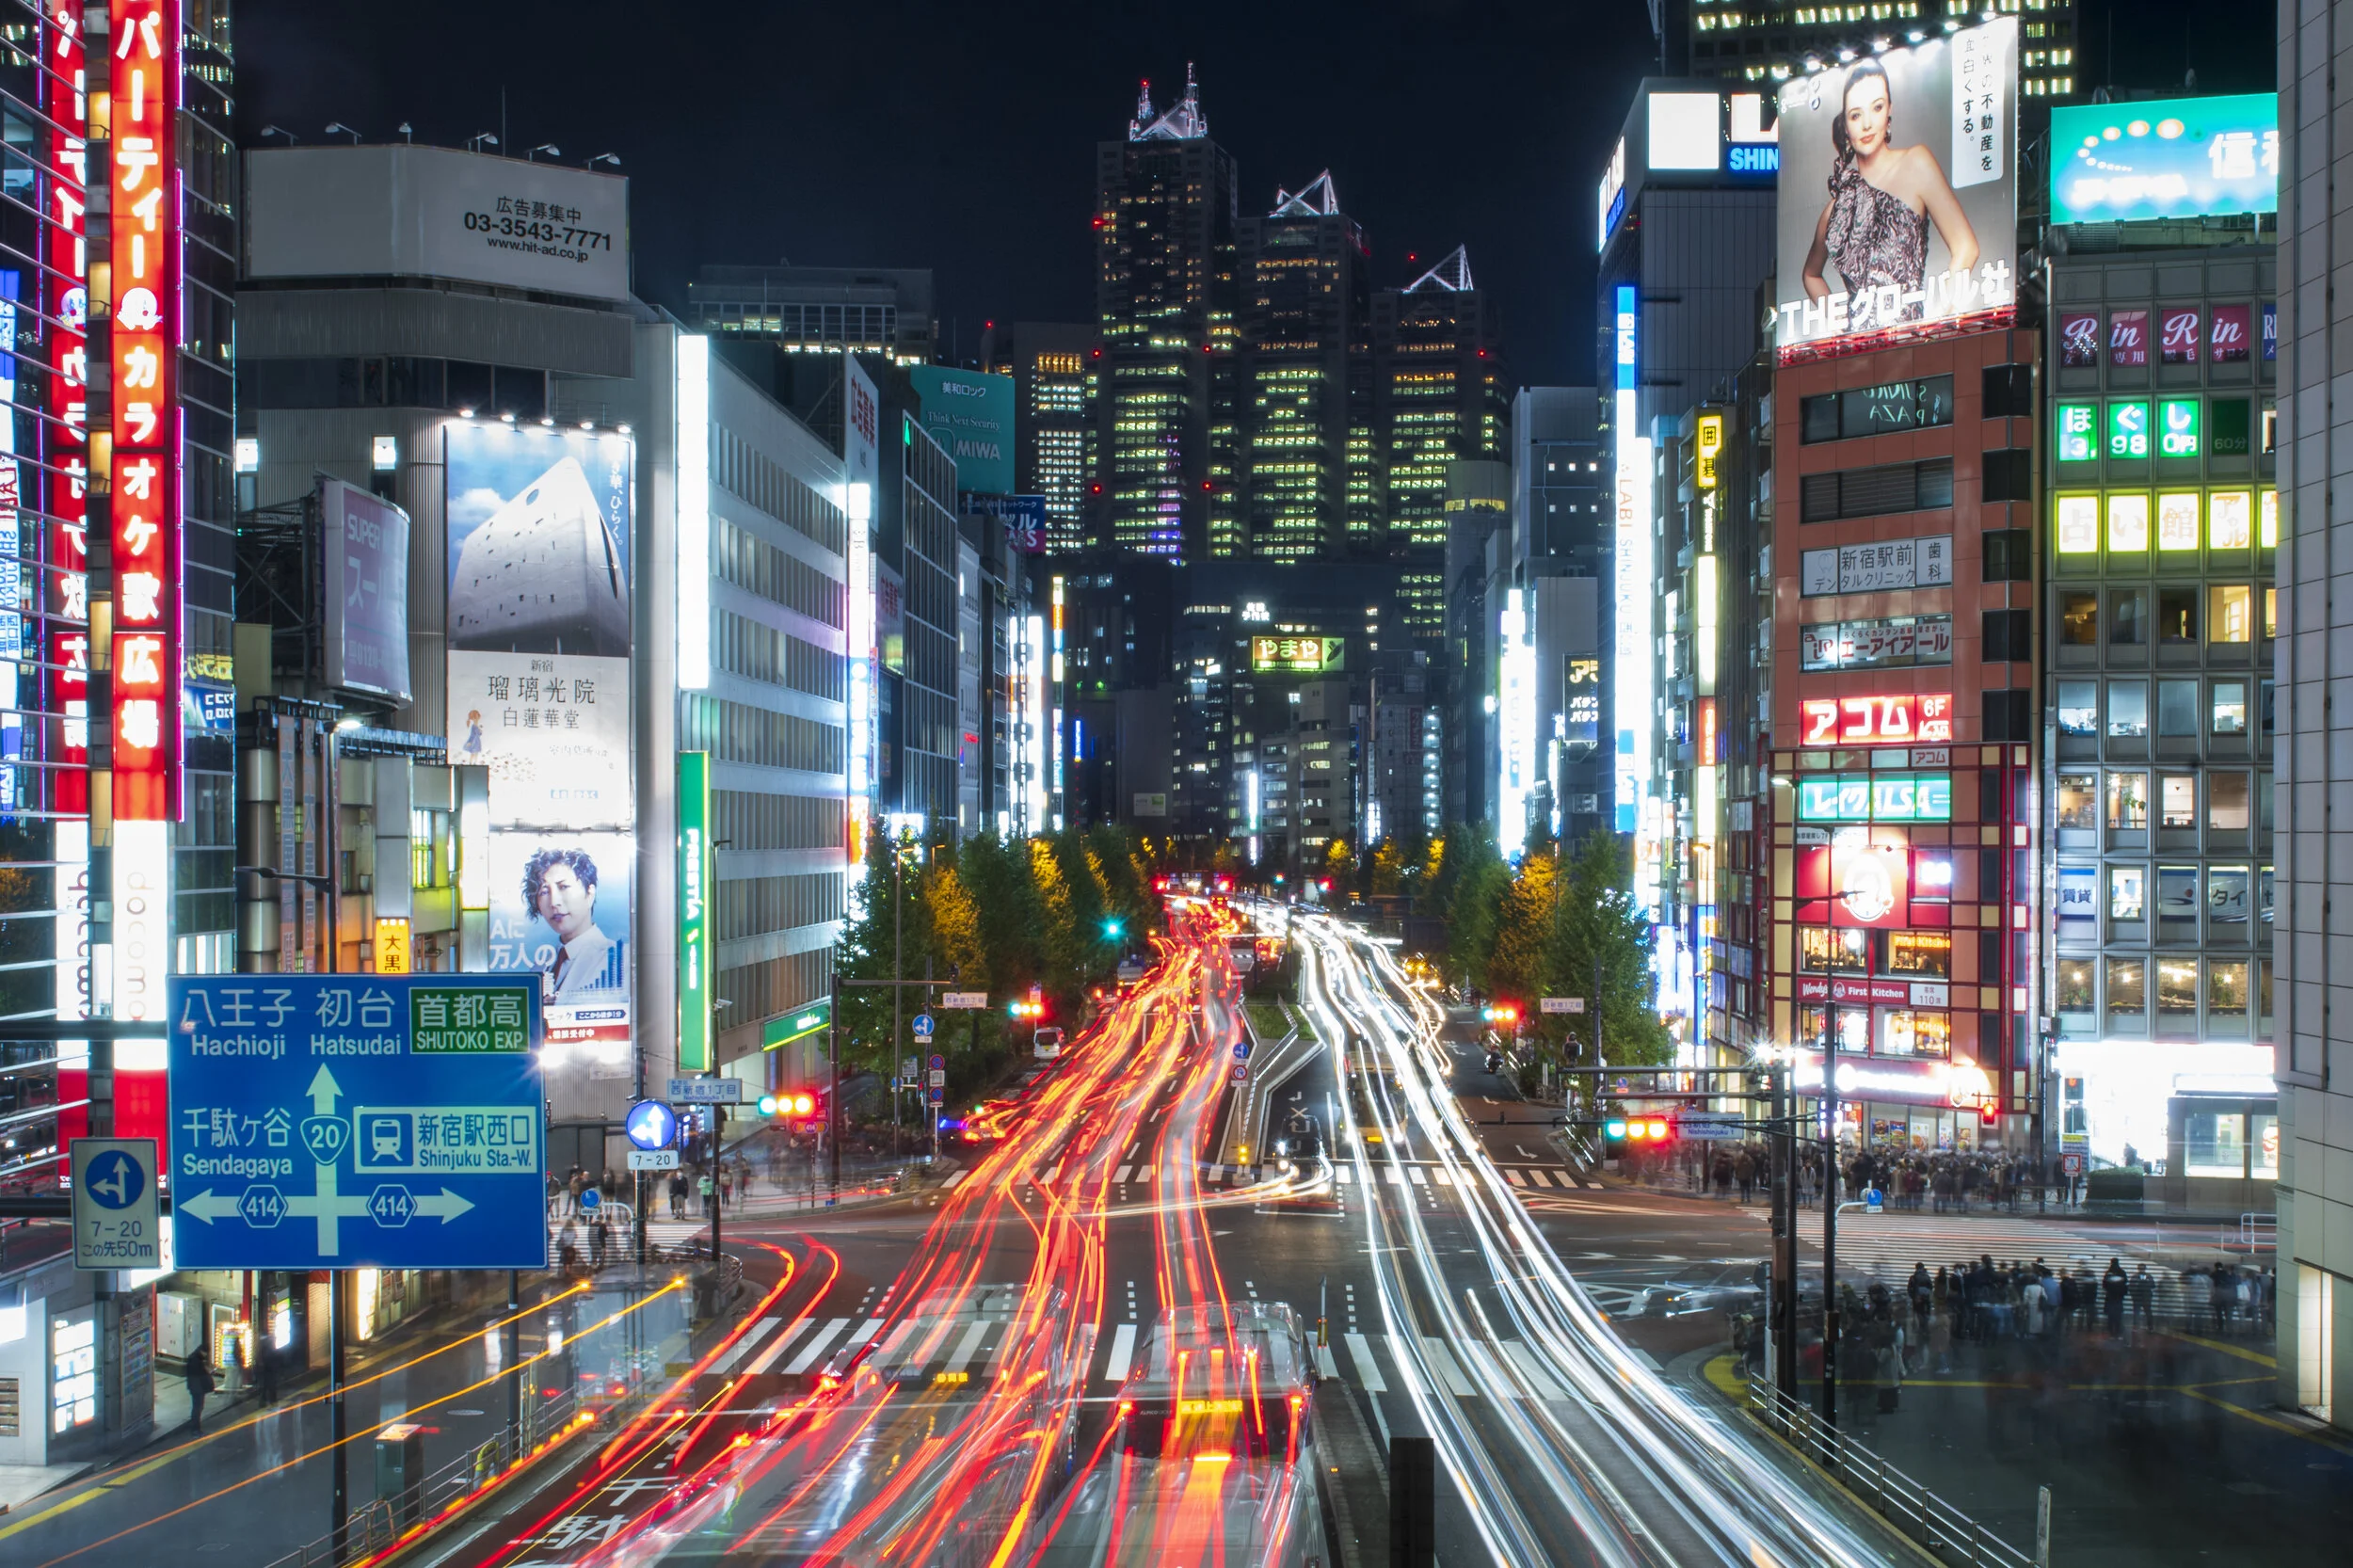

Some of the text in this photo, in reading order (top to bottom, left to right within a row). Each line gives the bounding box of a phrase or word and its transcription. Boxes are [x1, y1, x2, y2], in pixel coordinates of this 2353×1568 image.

[116, 10, 163, 279] パーティー
[495, 196, 582, 225] 広告募集中
[464, 212, 612, 251] 03-3543-7771
[487, 236, 589, 264] www.hit-ad.co.jp
[942, 381, 986, 397] 美和ロック
[928, 411, 1000, 431] Think Next Security
[2066, 403, 2192, 433] ほぐし
[956, 440, 1000, 460] MIWA
[2215, 438, 2248, 450] 60分
[348, 513, 380, 551] SUPER
[2062, 505, 2197, 544] 占い館
[1841, 545, 1913, 571] 新宿駅前
[1928, 541, 1942, 582] 歯科
[1815, 568, 1916, 592] デンタルクリニック
[1258, 639, 1319, 659] やまや
[1841, 632, 1950, 659] エーアイアール
[530, 659, 554, 673] 新宿
[488, 675, 596, 704] 瑠璃光院
[503, 708, 581, 730] 白蓮華堂
[1808, 699, 1910, 740] アコム
[1924, 698, 1945, 717] 6F
[1915, 751, 1945, 763] アコム
[2062, 888, 2091, 904] 賃貸
[127, 872, 154, 1020] docomo
[489, 944, 556, 969] 万人の
[1848, 988, 1868, 997] First
[1872, 989, 1905, 999] Kitchen
[183, 988, 296, 1029] 八王子
[316, 988, 395, 1029] 初台
[416, 994, 522, 1028] 首都高
[191, 1034, 286, 1060] Hachioji
[311, 1034, 402, 1055] Hatsudai
[416, 1031, 523, 1049] SHUTOKO EXP
[671, 1084, 736, 1096] 西新宿1丁目
[182, 1108, 292, 1147] 千駄ヶ谷
[311, 1124, 340, 1148] 20
[417, 1113, 531, 1147] 新宿駅西口
[182, 1153, 293, 1176] Sendagaya
[419, 1149, 532, 1170] Shinjuku Sta.-W.
[635, 1155, 670, 1165] 7-20
[247, 1195, 280, 1216] 414
[376, 1195, 408, 1216] 414
[91, 1220, 142, 1237] 7-20
[82, 1240, 152, 1257] この先50m
